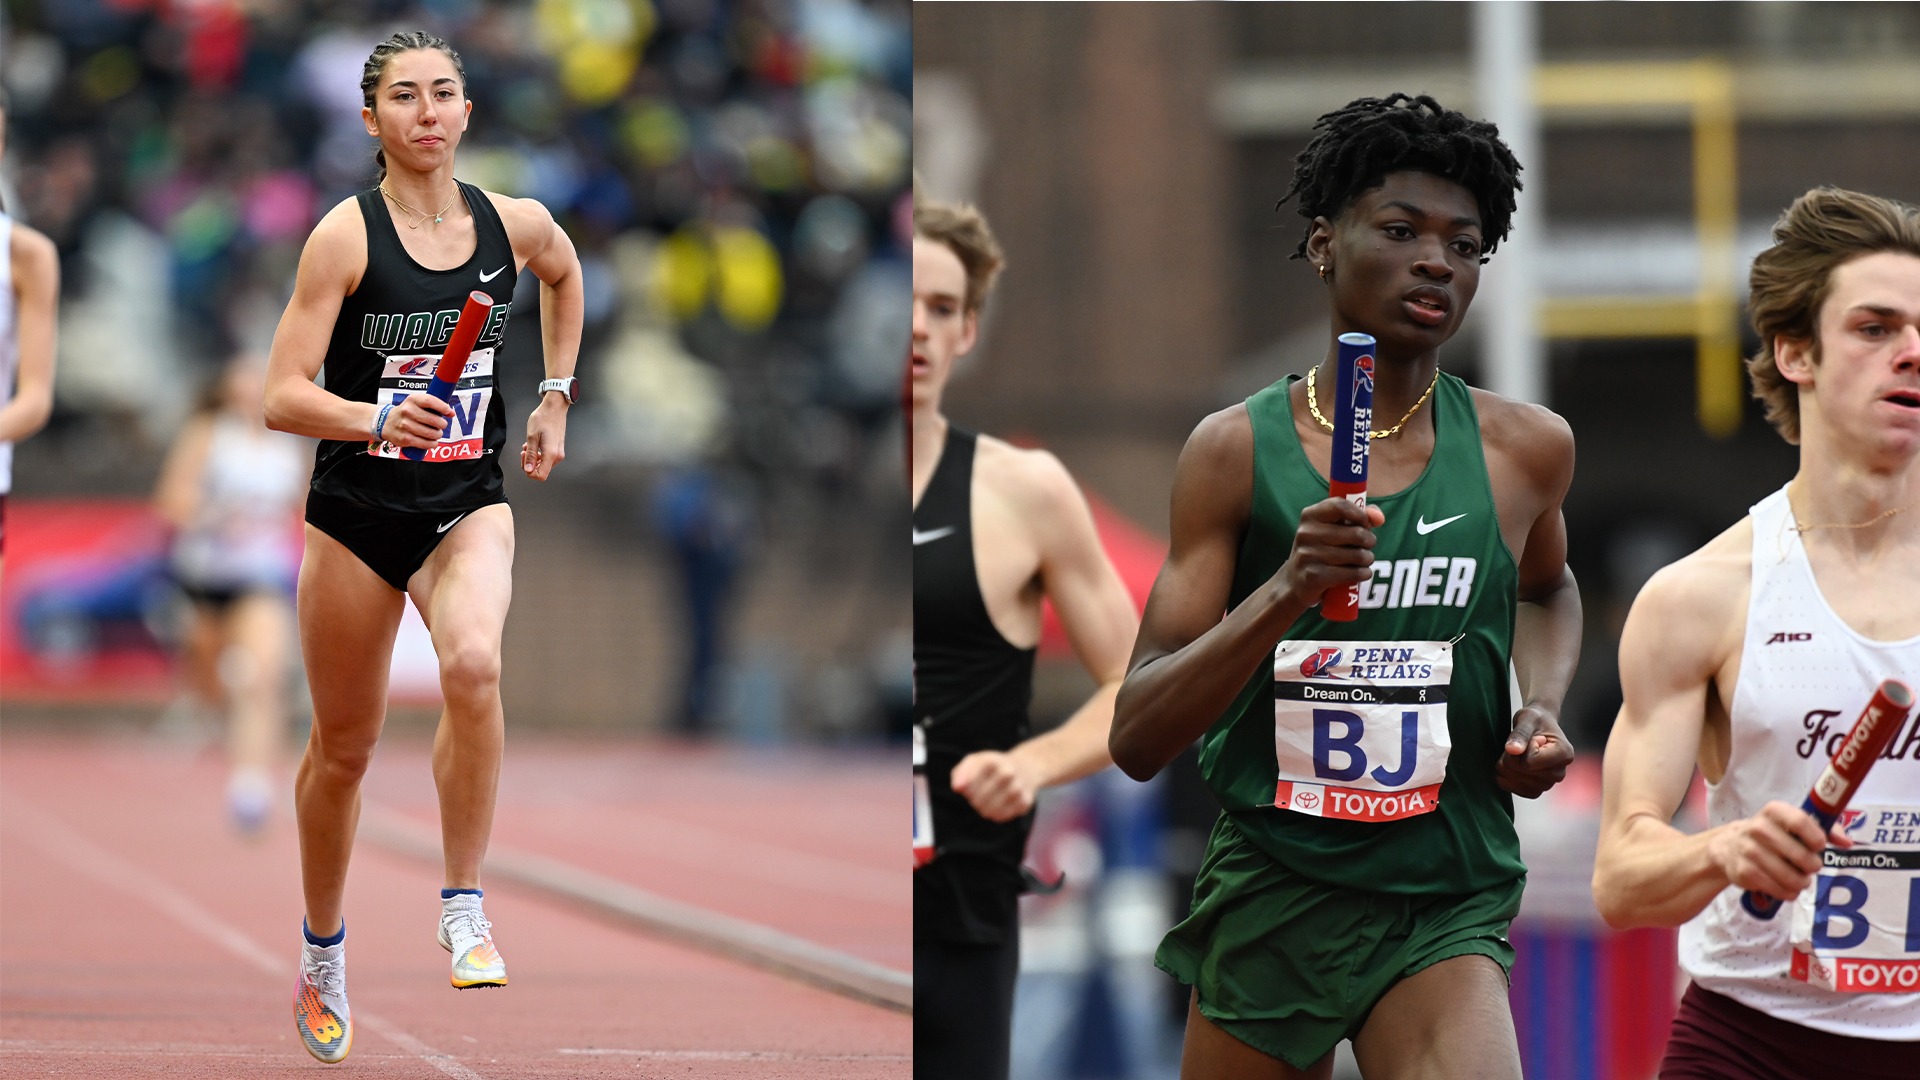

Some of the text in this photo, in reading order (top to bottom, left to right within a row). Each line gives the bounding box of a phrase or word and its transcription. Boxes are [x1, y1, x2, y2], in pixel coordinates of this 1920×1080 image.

[361, 303, 512, 350] WAGE
[398, 380, 428, 389] Dream
[392, 393, 481, 438] N
[1350, 406, 1366, 475] RELAYS
[426, 443, 471, 459] YOTA
[1357, 556, 1477, 609] GNER
[1765, 632, 1813, 646] A10
[1352, 648, 1414, 663] PENN
[1349, 664, 1432, 679] RELAYS
[1303, 686, 1376, 702] Dream On.
[1835, 705, 1883, 770] TOYOTA
[1312, 708, 1419, 788] BJ
[1330, 791, 1425, 817] TOYOTA
[1877, 811, 1920, 827] PEN
[1873, 828, 1920, 844] REL
[1824, 851, 1900, 868] Dream On.
[1841, 963, 1920, 988] TOYO
